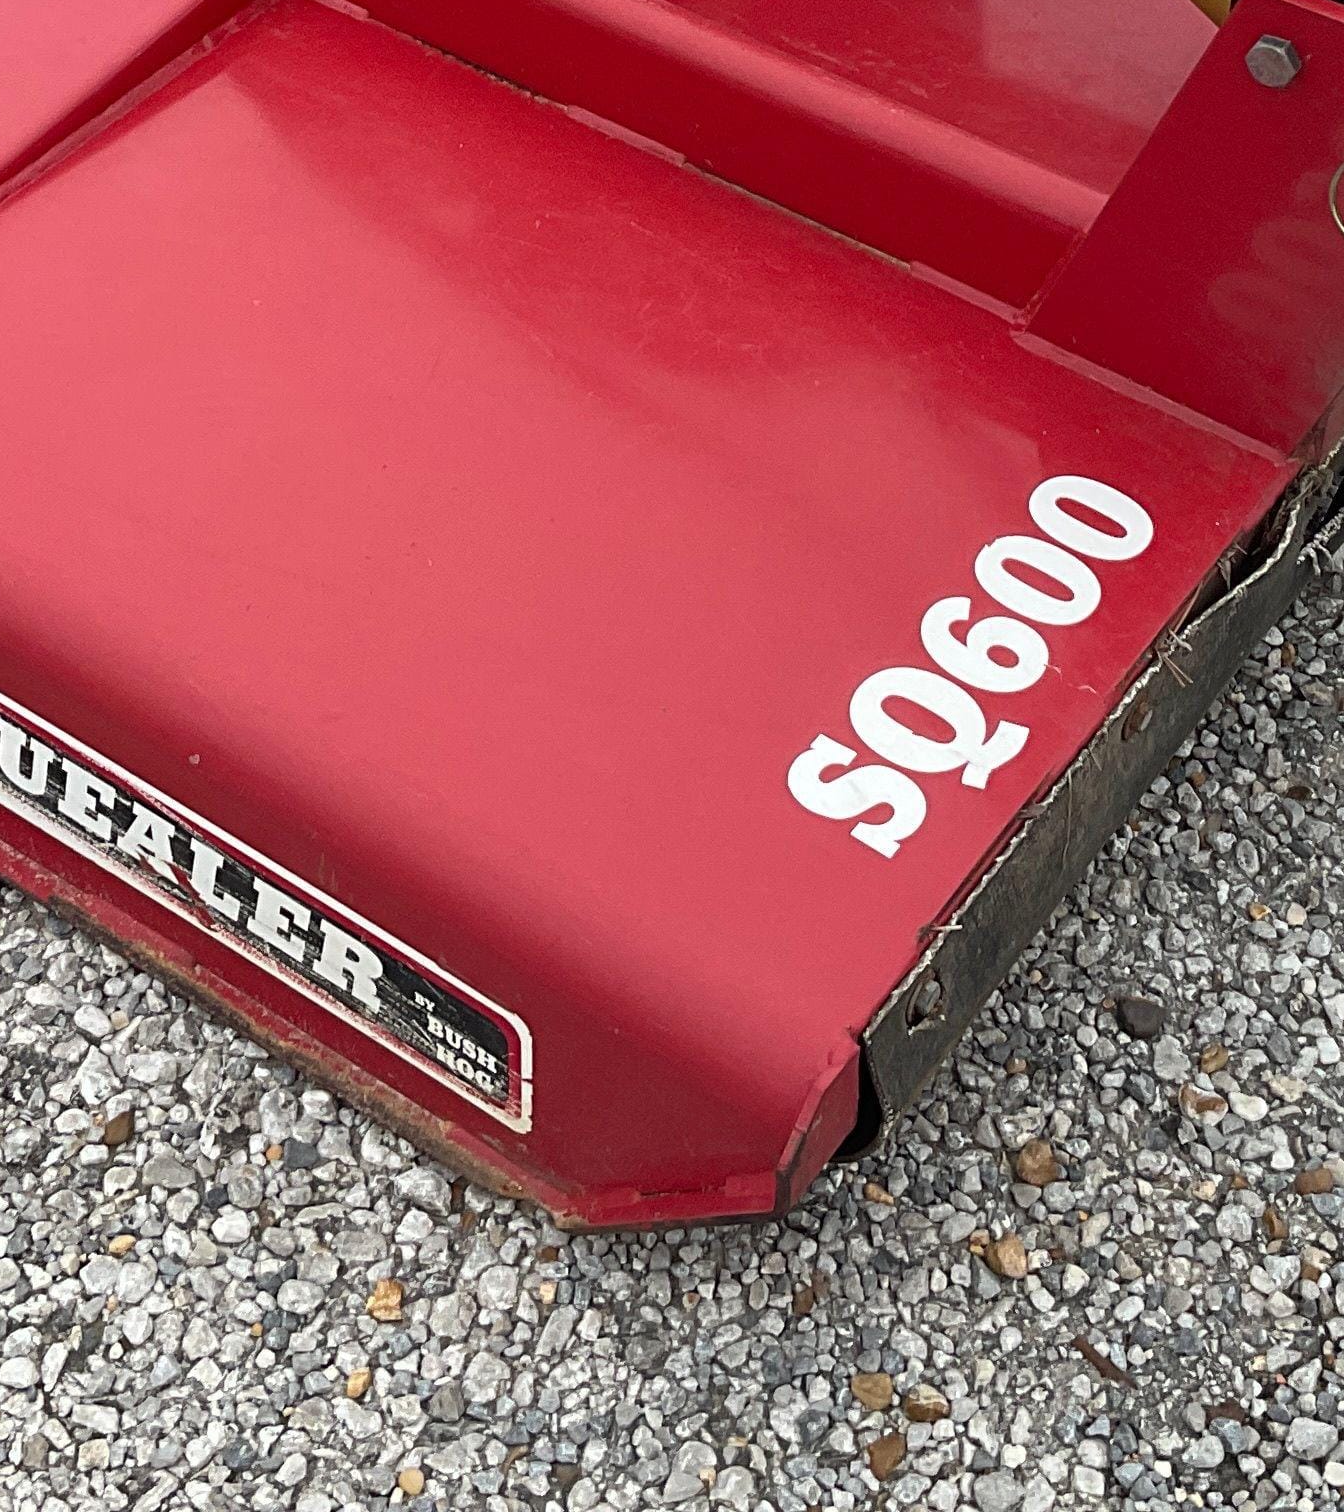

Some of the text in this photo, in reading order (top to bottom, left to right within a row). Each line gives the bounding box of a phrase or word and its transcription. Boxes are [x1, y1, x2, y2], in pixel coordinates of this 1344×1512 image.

[787, 474, 1154, 859] SQ600
[414, 991, 435, 1012] BY
[426, 1012, 497, 1074] BUSH
